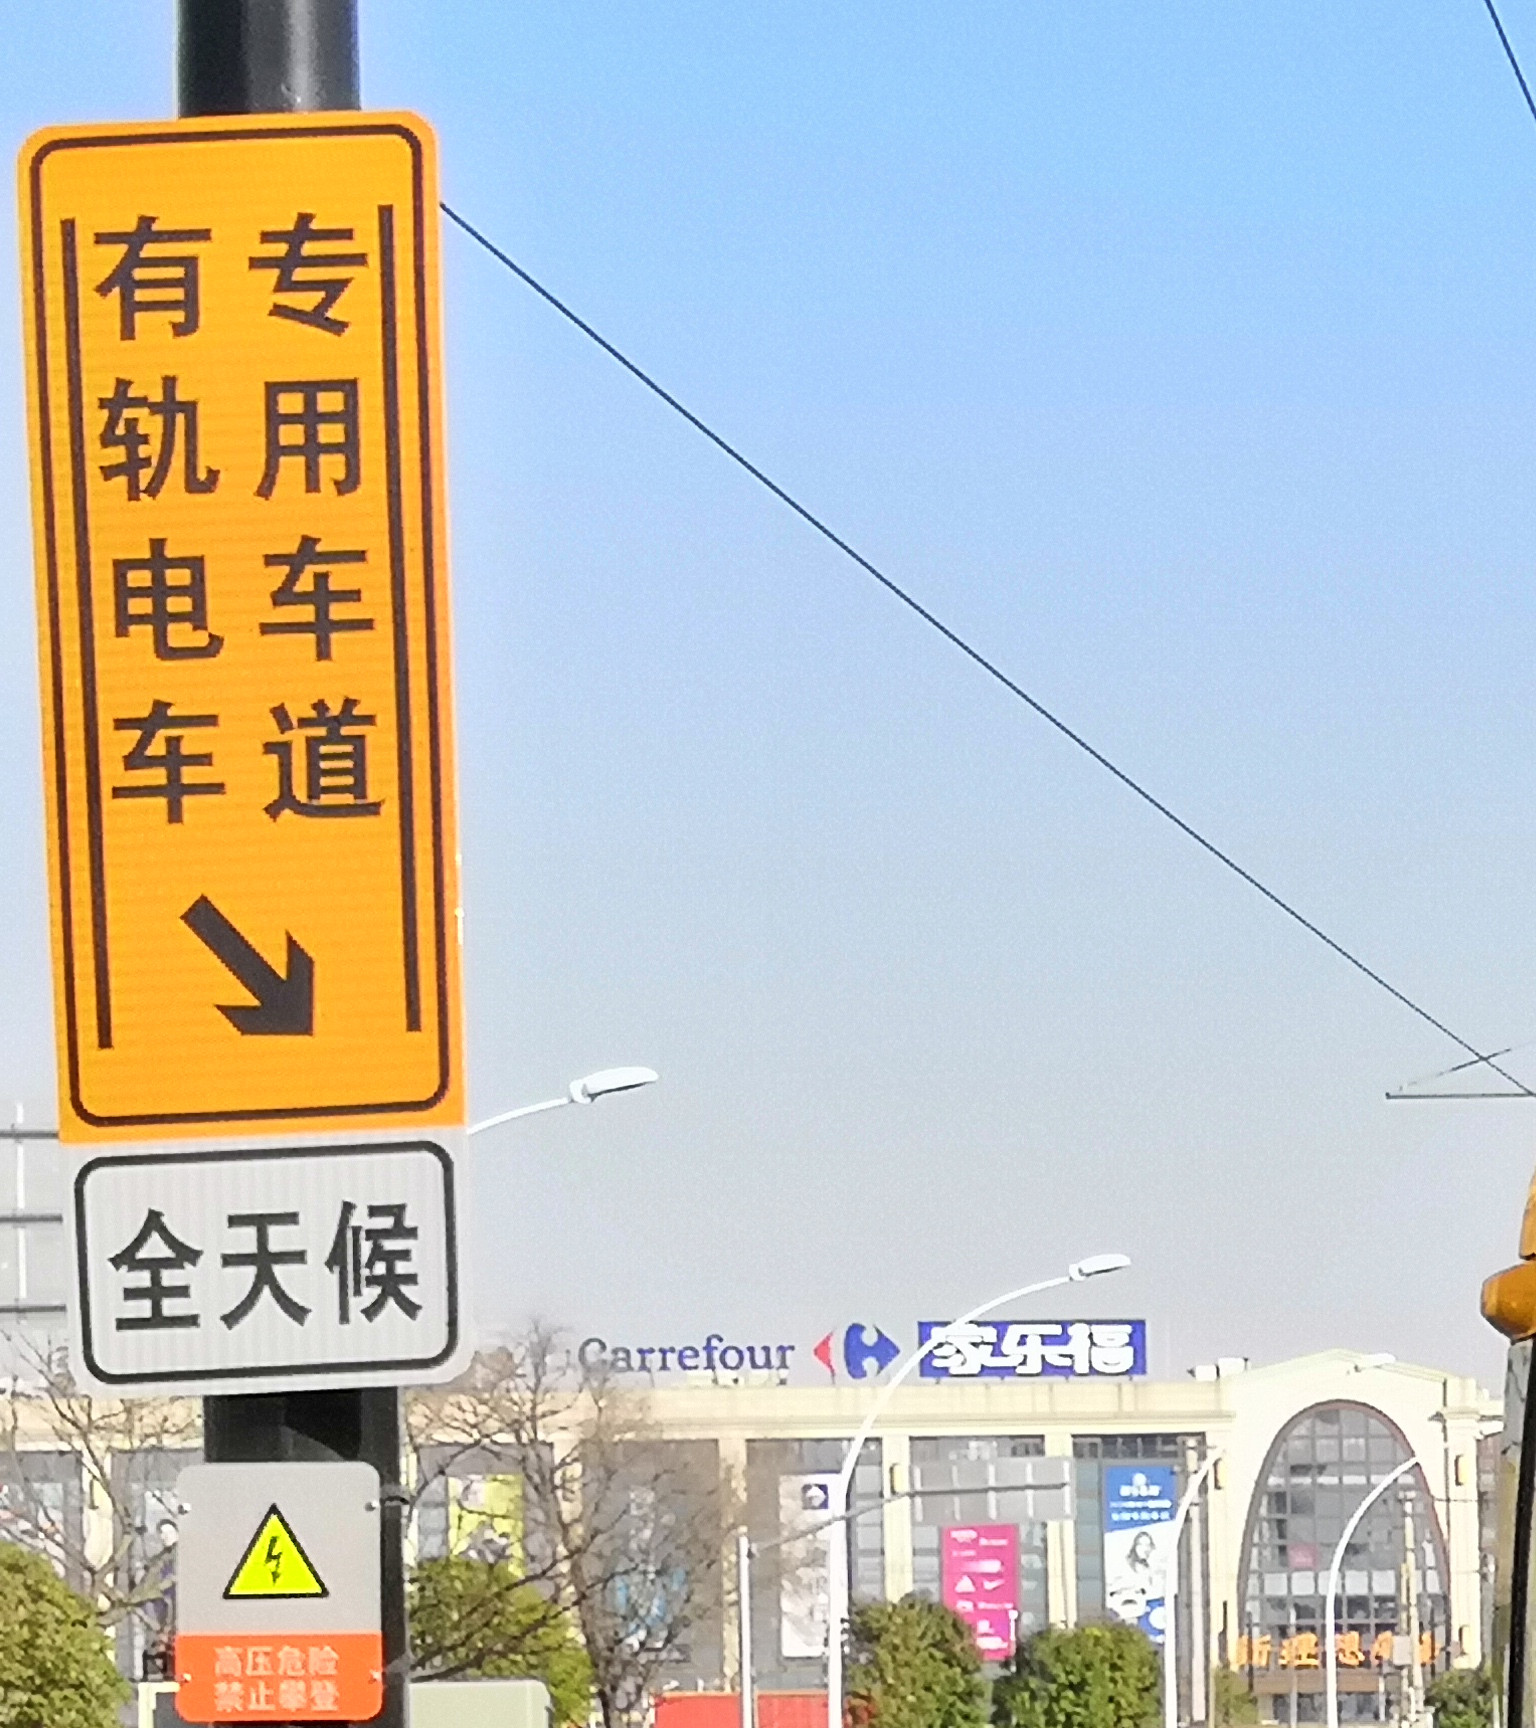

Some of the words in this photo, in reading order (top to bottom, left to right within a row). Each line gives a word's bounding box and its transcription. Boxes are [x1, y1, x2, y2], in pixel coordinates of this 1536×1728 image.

[94, 214, 227, 824] 有轨电车
[247, 211, 385, 821] 专用车道
[108, 1199, 422, 1331] 全天候
[578, 1334, 796, 1371] Carrefour
[930, 1322, 1134, 1375] 家乐福
[214, 1645, 340, 1678] 高压危险
[214, 1679, 340, 1713] 禁止攀登
